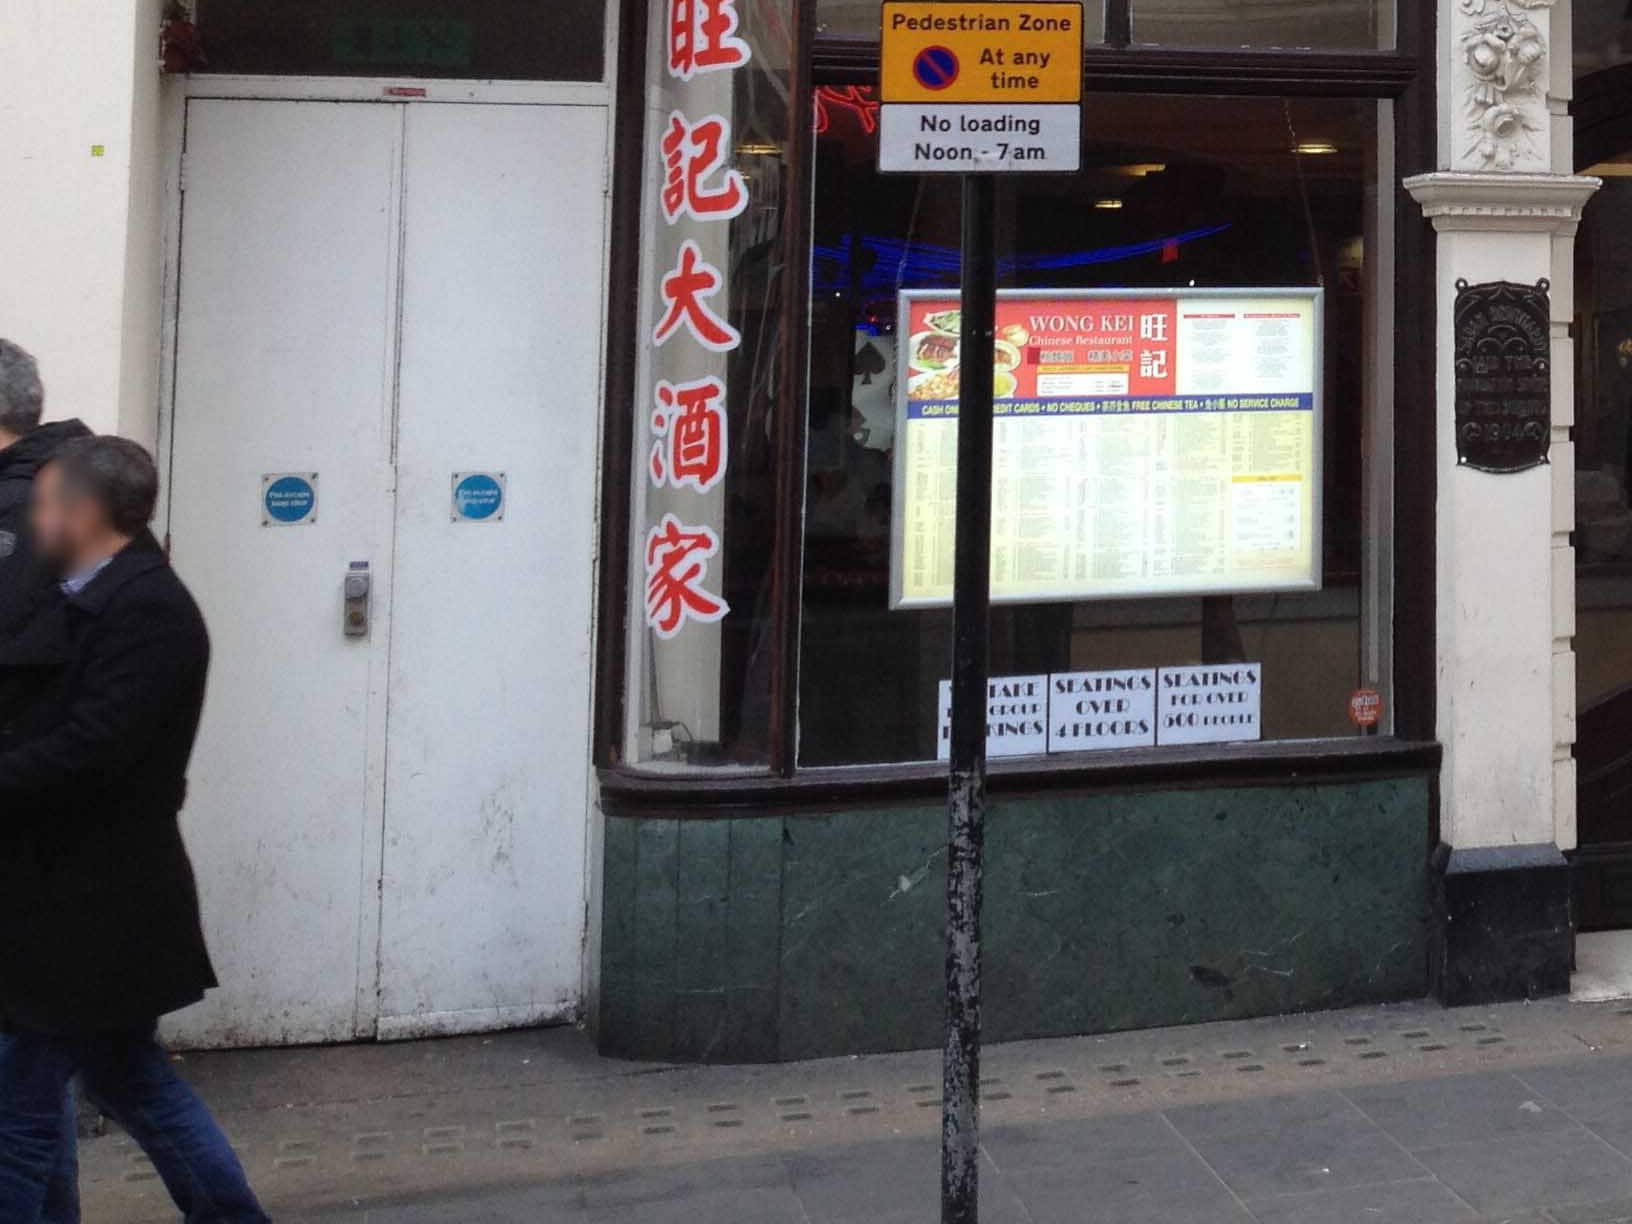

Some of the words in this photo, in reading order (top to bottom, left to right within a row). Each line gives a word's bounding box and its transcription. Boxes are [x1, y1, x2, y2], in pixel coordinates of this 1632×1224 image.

[892, 13, 1010, 32] Pedestrian
[1018, 14, 1072, 32] Zone
[979, 48, 1005, 66] At
[1012, 51, 1051, 69] any
[990, 72, 1039, 90] time
[920, 116, 951, 133] No
[960, 115, 1041, 136] loading
[914, 144, 972, 161] Noon
[1029, 315, 1094, 333] WONG
[1101, 314, 1134, 332] KEI
[1029, 335, 1073, 346] Chinese
[1076, 334, 1133, 346] Restaurant
[1140, 313, 1168, 379] 旺記
[945, 403, 960, 415] ON
[992, 402, 1012, 414] EDIT
[1055, 675, 1150, 694] SEATINGS
[1163, 670, 1256, 688] SEATINGS
[989, 682, 1040, 698] TAKE
[1171, 693, 1200, 706] FOR
[1206, 691, 1248, 705] OVER
[989, 703, 1040, 715] GROUP
[1075, 698, 1130, 715] OVER
[1055, 723, 1067, 738] 4
[1072, 719, 1149, 737] FLOORS
[1163, 712, 1199, 728] 500
